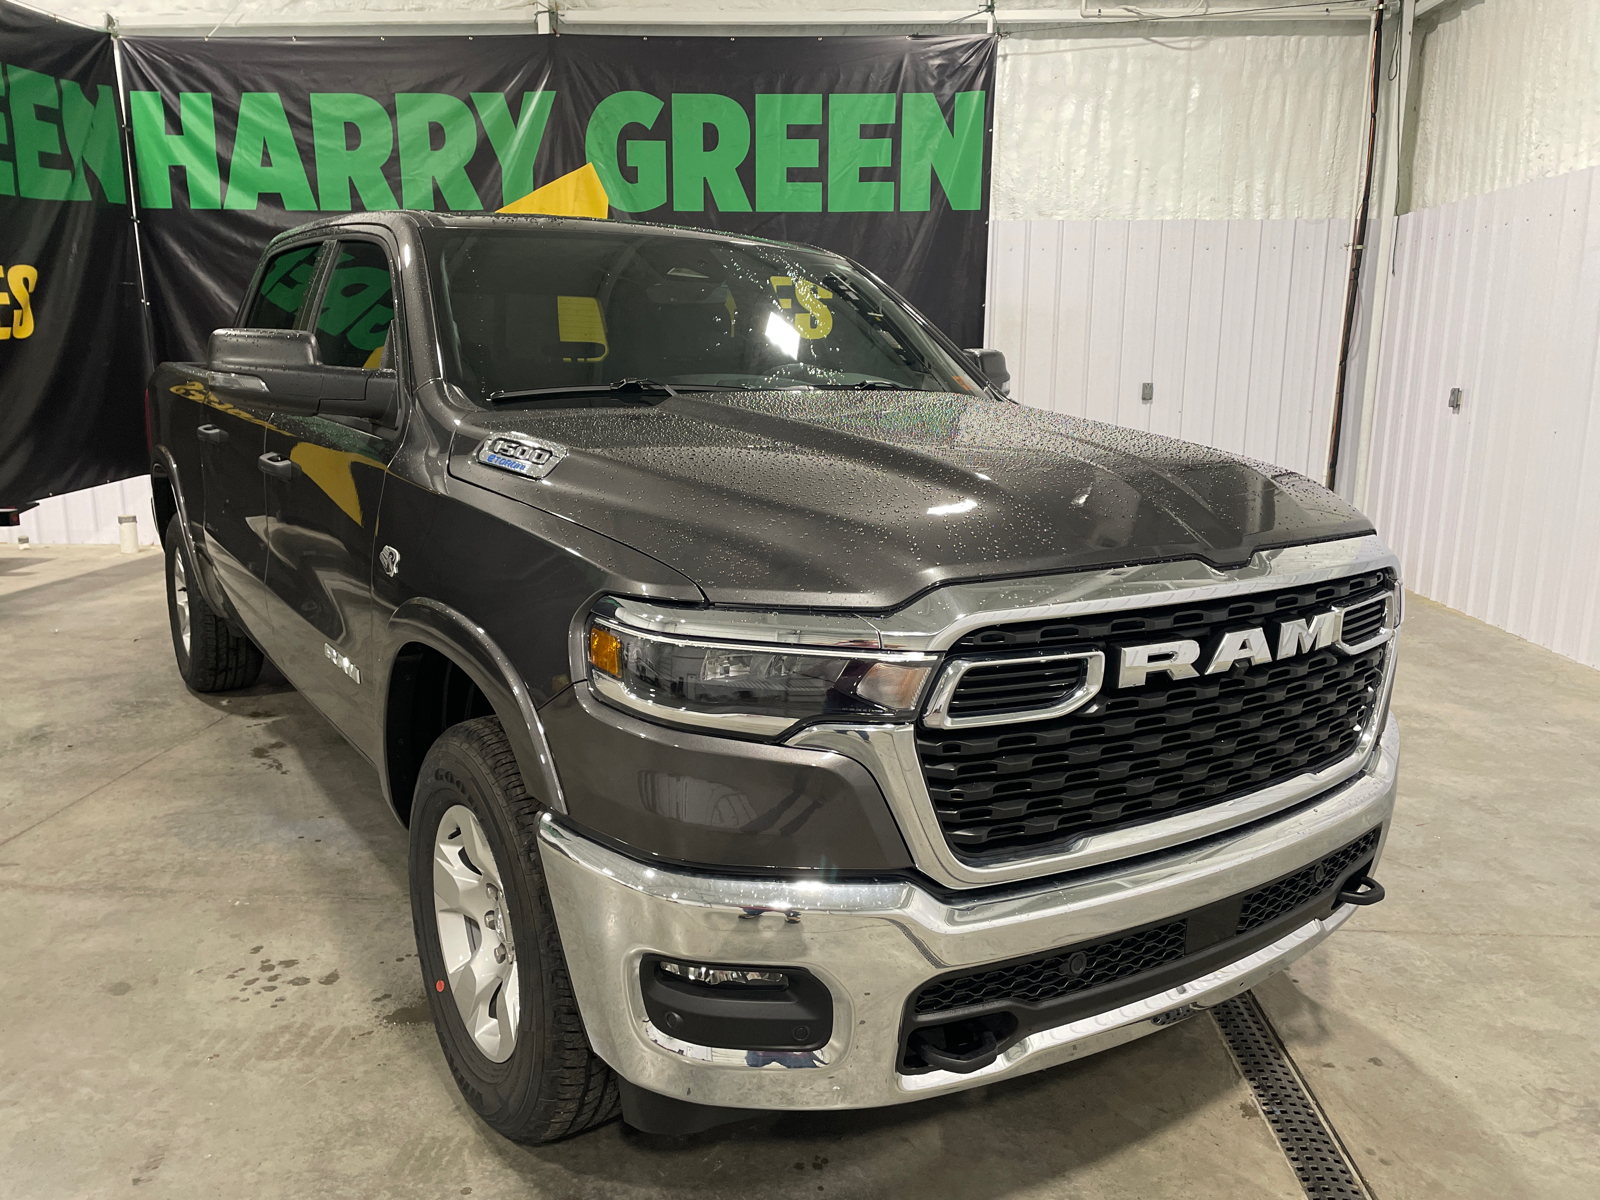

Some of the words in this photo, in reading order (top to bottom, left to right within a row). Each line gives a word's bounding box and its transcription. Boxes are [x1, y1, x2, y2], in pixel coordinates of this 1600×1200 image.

[129, 91, 556, 211] HARRY
[585, 91, 986, 213] GREEN
[494, 439, 553, 465] 1500
[1118, 611, 1341, 689] RAM
